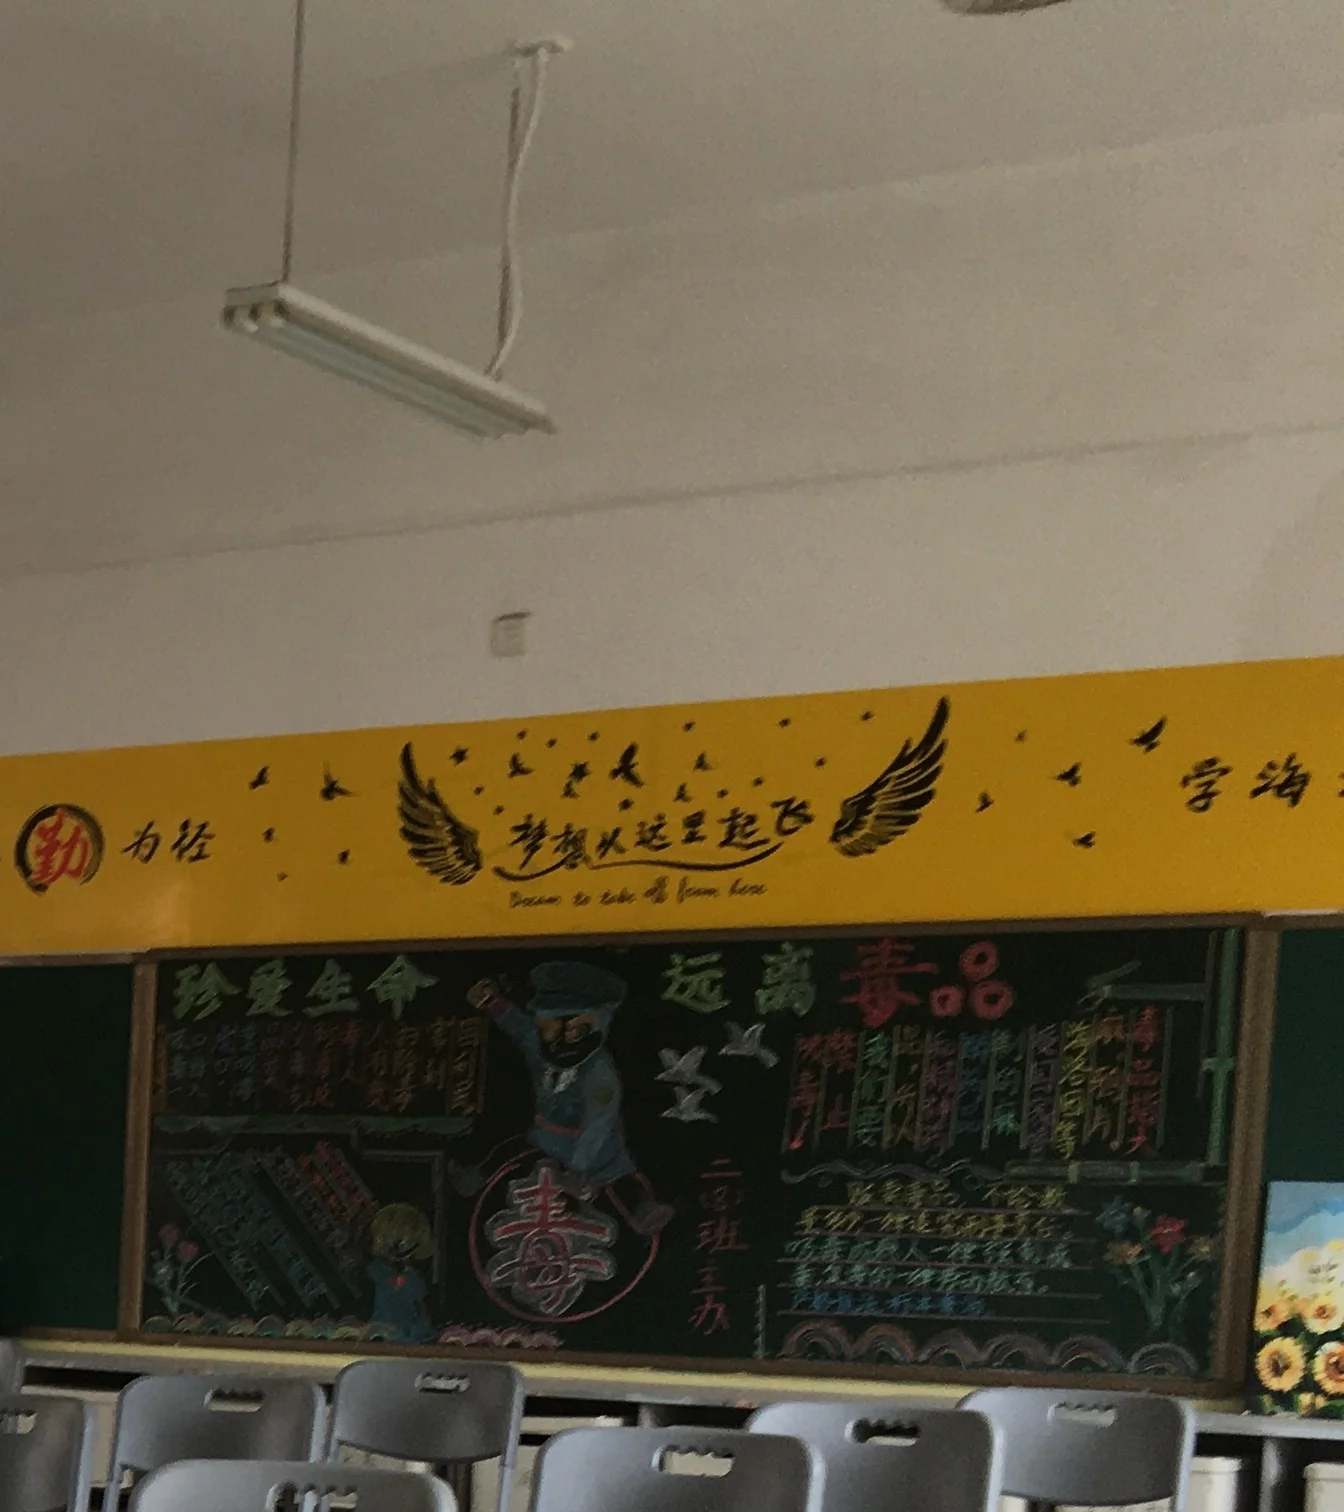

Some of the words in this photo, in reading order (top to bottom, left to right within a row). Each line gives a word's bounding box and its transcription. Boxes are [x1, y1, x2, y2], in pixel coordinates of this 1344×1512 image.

[1179, 752, 1344, 810] 学海
[510, 796, 816, 870] 梦想从这里起飞
[172, 953, 441, 1022] 珍爱生命
[658, 936, 1016, 1029] 远离毒品
[482, 1163, 617, 1318] 毒
